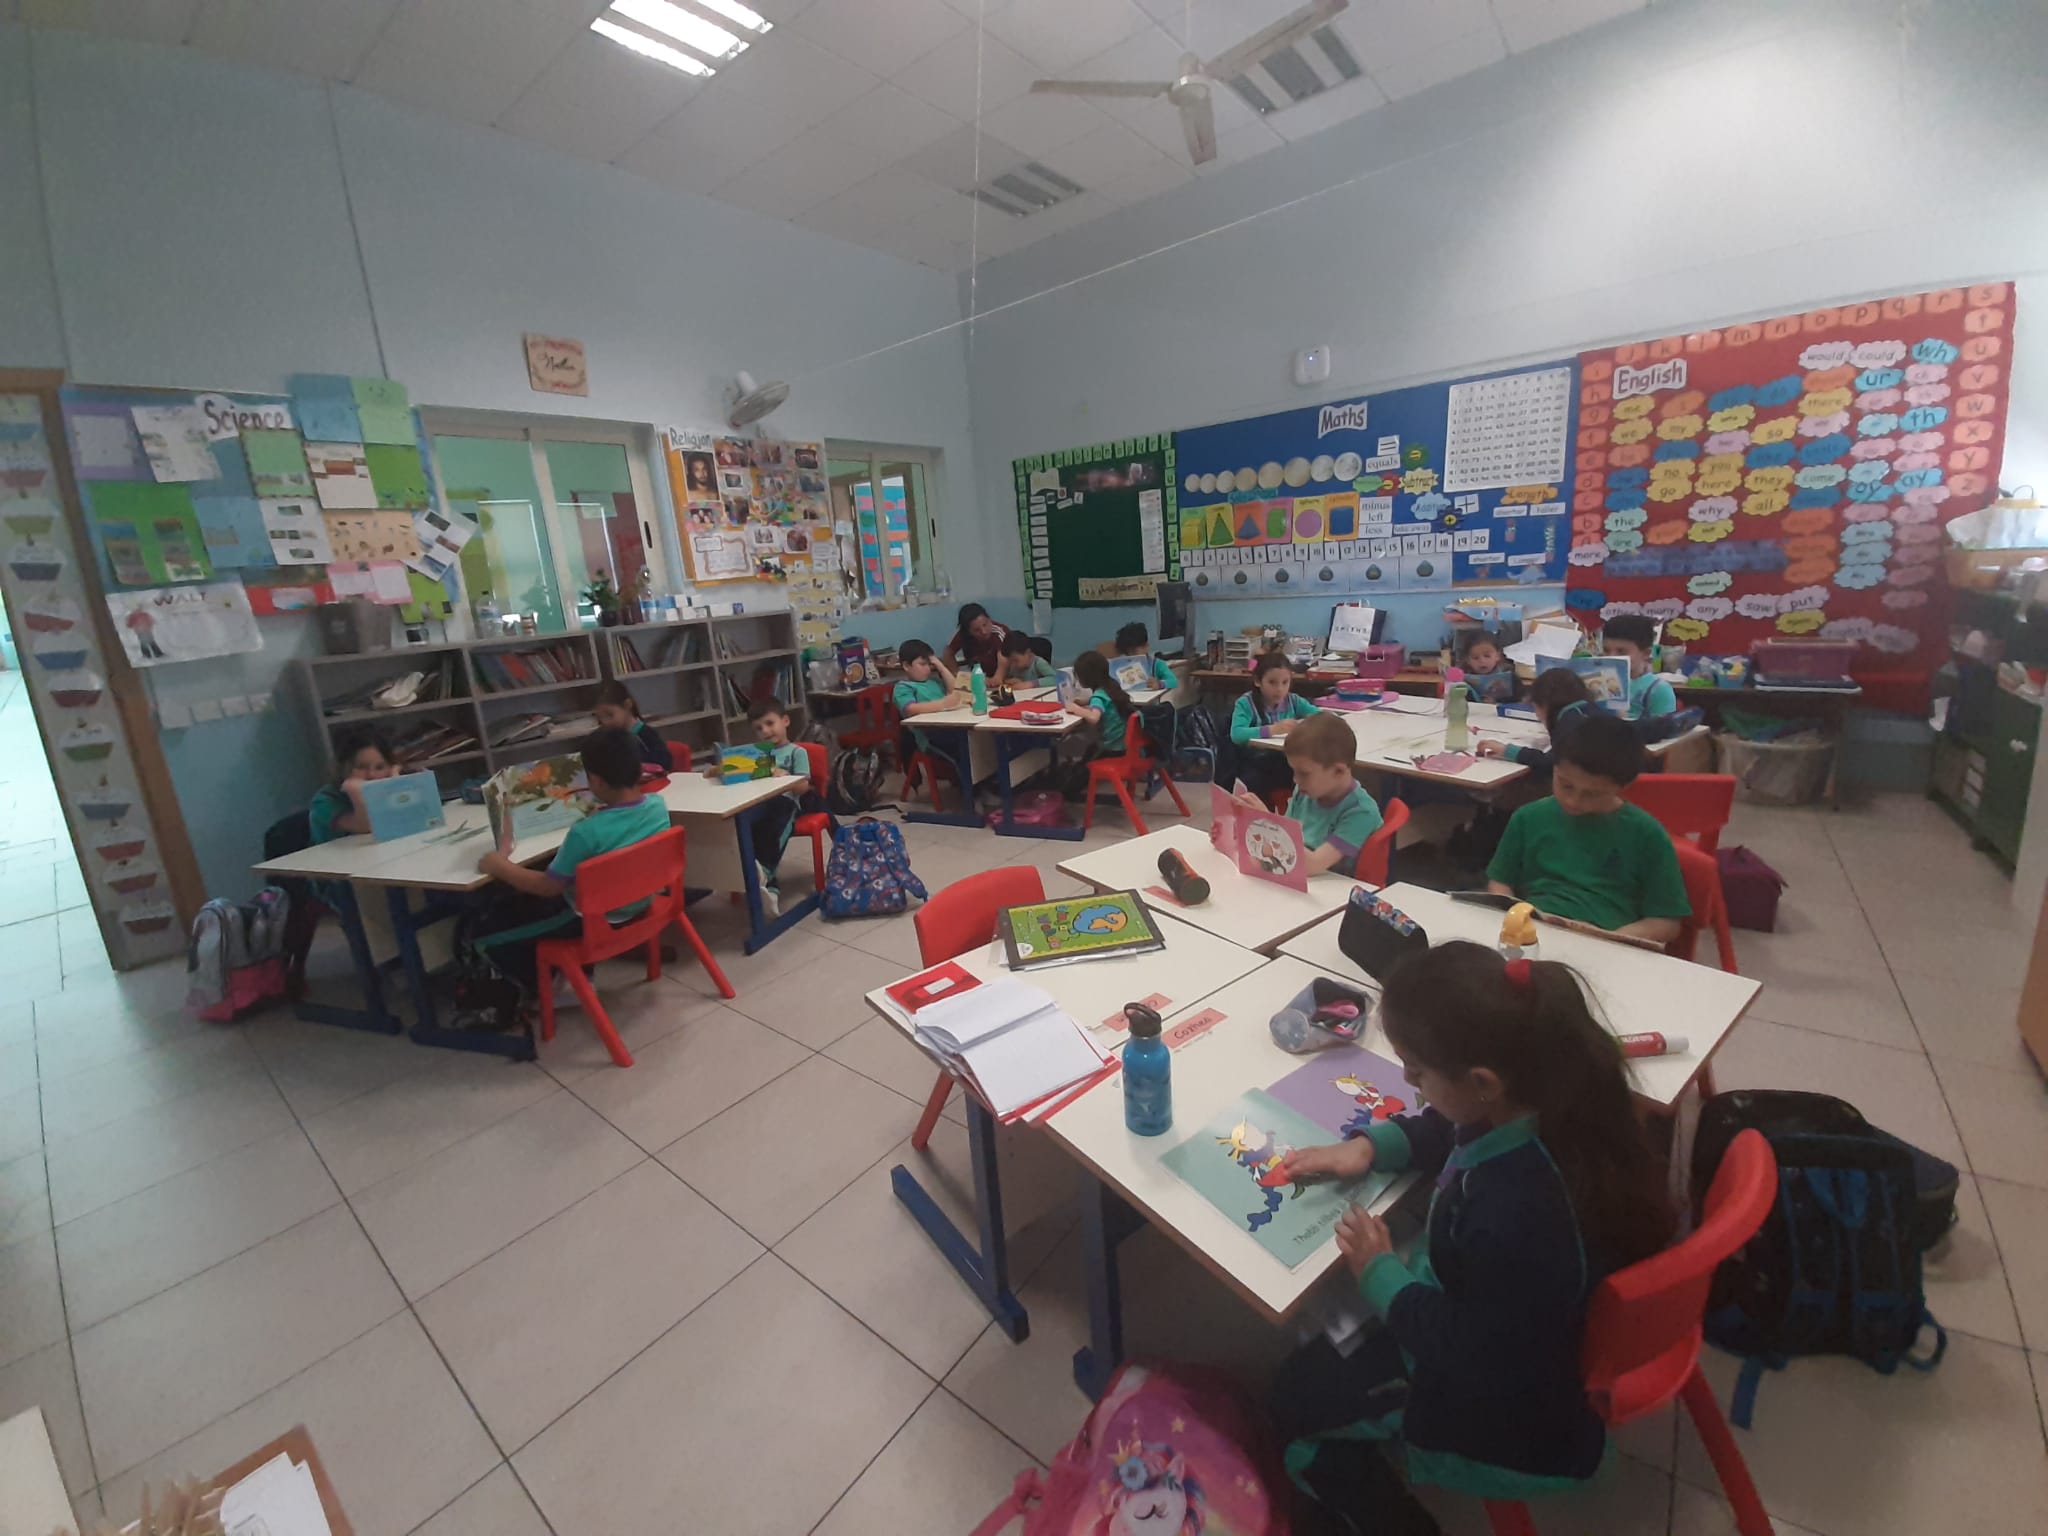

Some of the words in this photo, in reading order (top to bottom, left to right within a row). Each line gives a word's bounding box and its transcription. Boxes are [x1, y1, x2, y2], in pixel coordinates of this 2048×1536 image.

[1815, 313, 1826, 324] o
[1856, 307, 1868, 323] p
[1775, 321, 1787, 333] n
[1733, 329, 1750, 344] m
[1975, 342, 1986, 355] u
[1807, 351, 1845, 361] would
[1857, 350, 1896, 362] could
[1617, 361, 1683, 394] English
[1865, 372, 1891, 386] ur
[1966, 400, 1985, 412] w
[204, 399, 285, 435] Science
[1320, 407, 1366, 434] Maths
[1910, 408, 1936, 427] th
[1967, 425, 1980, 438] x
[1367, 457, 1399, 471] equals
[1962, 450, 1977, 467] y
[1663, 468, 1680, 478] no
[1902, 470, 1929, 487] ay
[1753, 476, 1785, 488] they
[1509, 487, 1549, 501] Length
[1660, 487, 1677, 498] go
[1361, 501, 1391, 511] minus
[1756, 498, 1774, 511] all
[1368, 511, 1384, 521] left
[1697, 505, 1725, 518] why
[1614, 517, 1636, 528] the
[1365, 524, 1384, 535] less
[1388, 543, 1398, 552] 15
[1405, 541, 1415, 551] 16
[1422, 539, 1432, 549] 17
[1439, 538, 1449, 547] 18
[1456, 536, 1468, 546] 19
[1473, 535, 1487, 545] 20
[1573, 552, 1602, 560] more
[1745, 602, 1772, 613] saw
[1790, 595, 1814, 610] put
[1696, 605, 1720, 617] any
